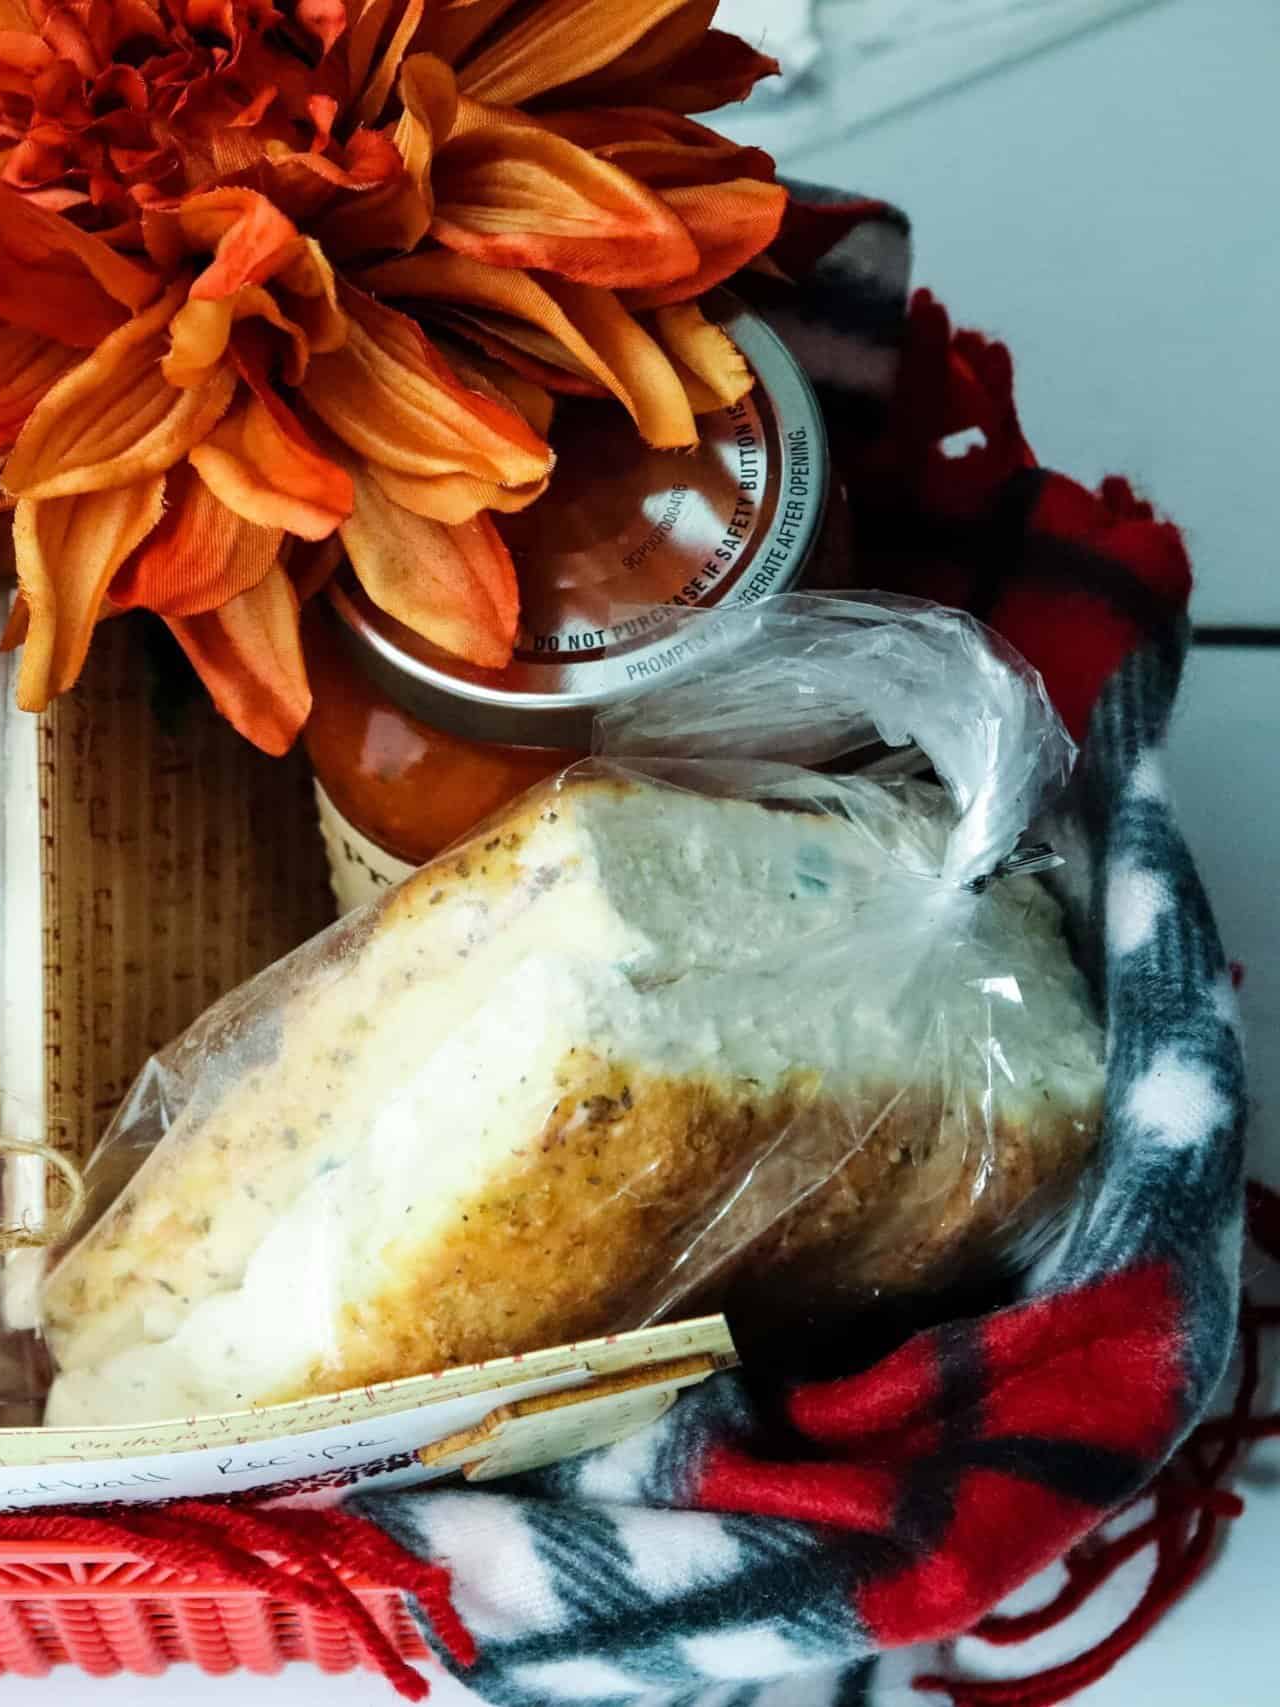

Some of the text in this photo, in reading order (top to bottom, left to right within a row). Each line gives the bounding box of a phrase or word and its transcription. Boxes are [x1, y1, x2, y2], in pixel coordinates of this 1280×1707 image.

[787, 426, 809, 498] OPENING.
[534, 635, 560, 651] DO
[568, 629, 608, 650] NOT
[701, 560, 722, 581] IF
[715, 499, 755, 561] SAFETY
[735, 424, 759, 491] BUTTON
[776, 501, 808, 550] AFTER
[217, 1436, 395, 1475] Recipe
